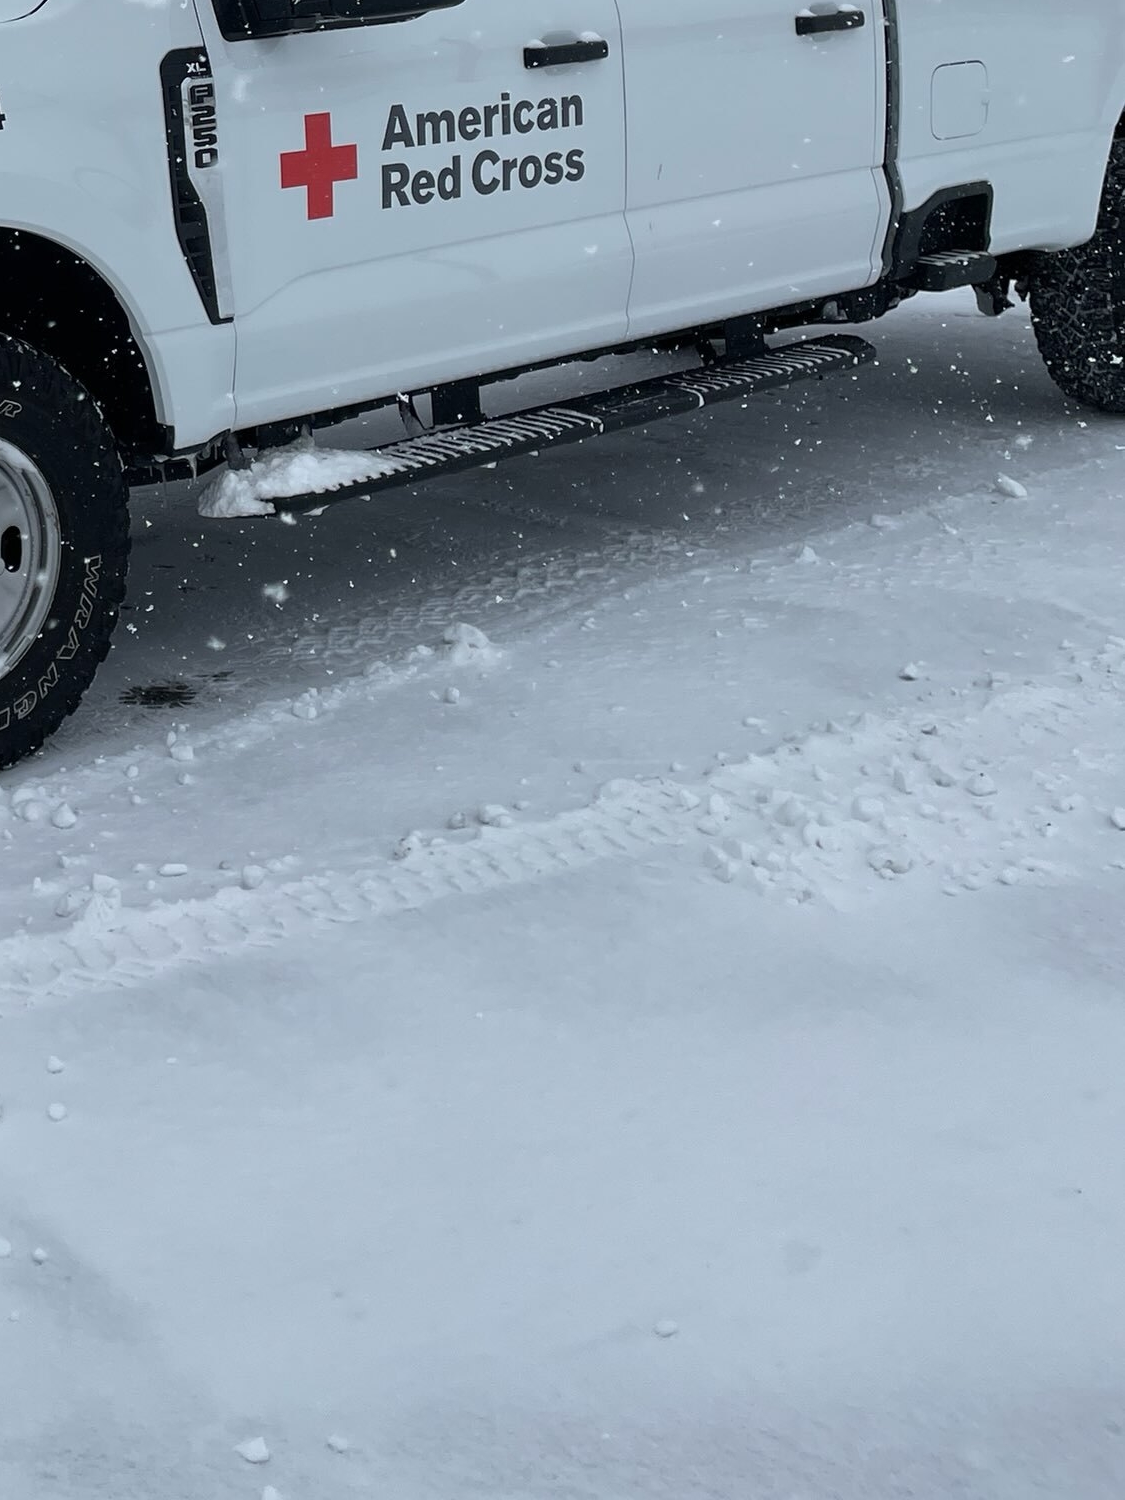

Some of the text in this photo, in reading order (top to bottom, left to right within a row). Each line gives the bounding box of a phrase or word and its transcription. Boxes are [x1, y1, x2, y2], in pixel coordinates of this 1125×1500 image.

[185, 61, 207, 74] XL
[189, 83, 219, 169] F250
[381, 92, 584, 151] American
[381, 148, 585, 209] Red Cross
